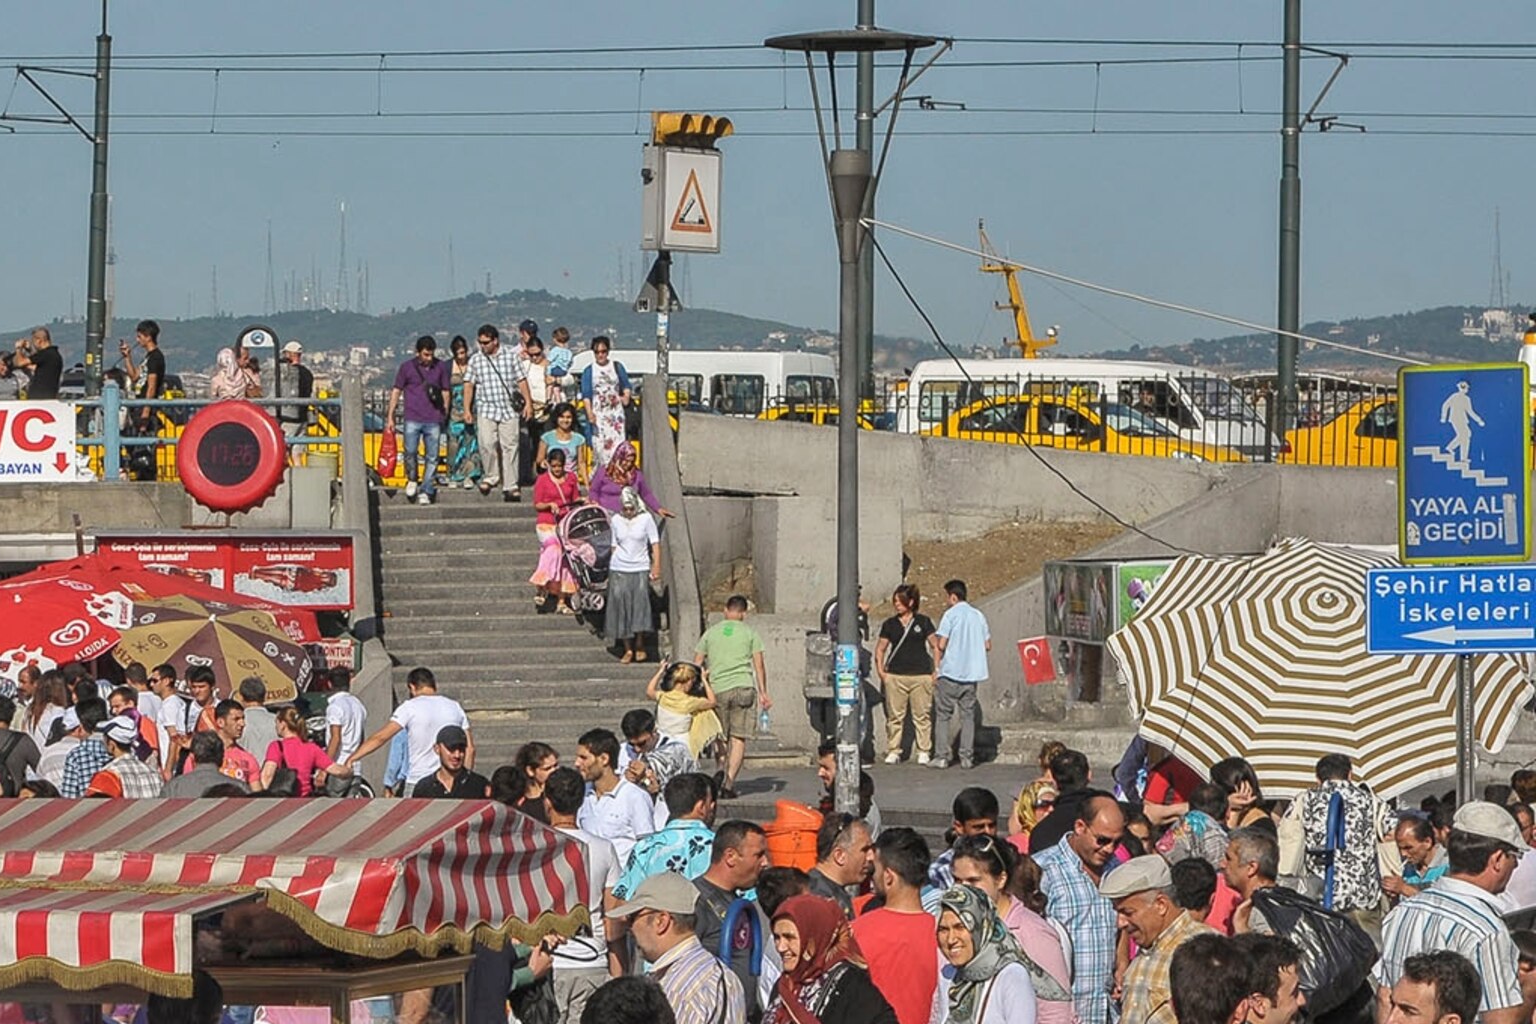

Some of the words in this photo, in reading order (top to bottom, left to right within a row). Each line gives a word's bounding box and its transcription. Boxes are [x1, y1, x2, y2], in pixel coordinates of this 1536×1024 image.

[1410, 496, 1469, 516] YAYA
[1423, 517, 1504, 544] GEÇİDİ
[1374, 572, 1449, 598] Şehir
[1399, 597, 1530, 622] İskeleleri
